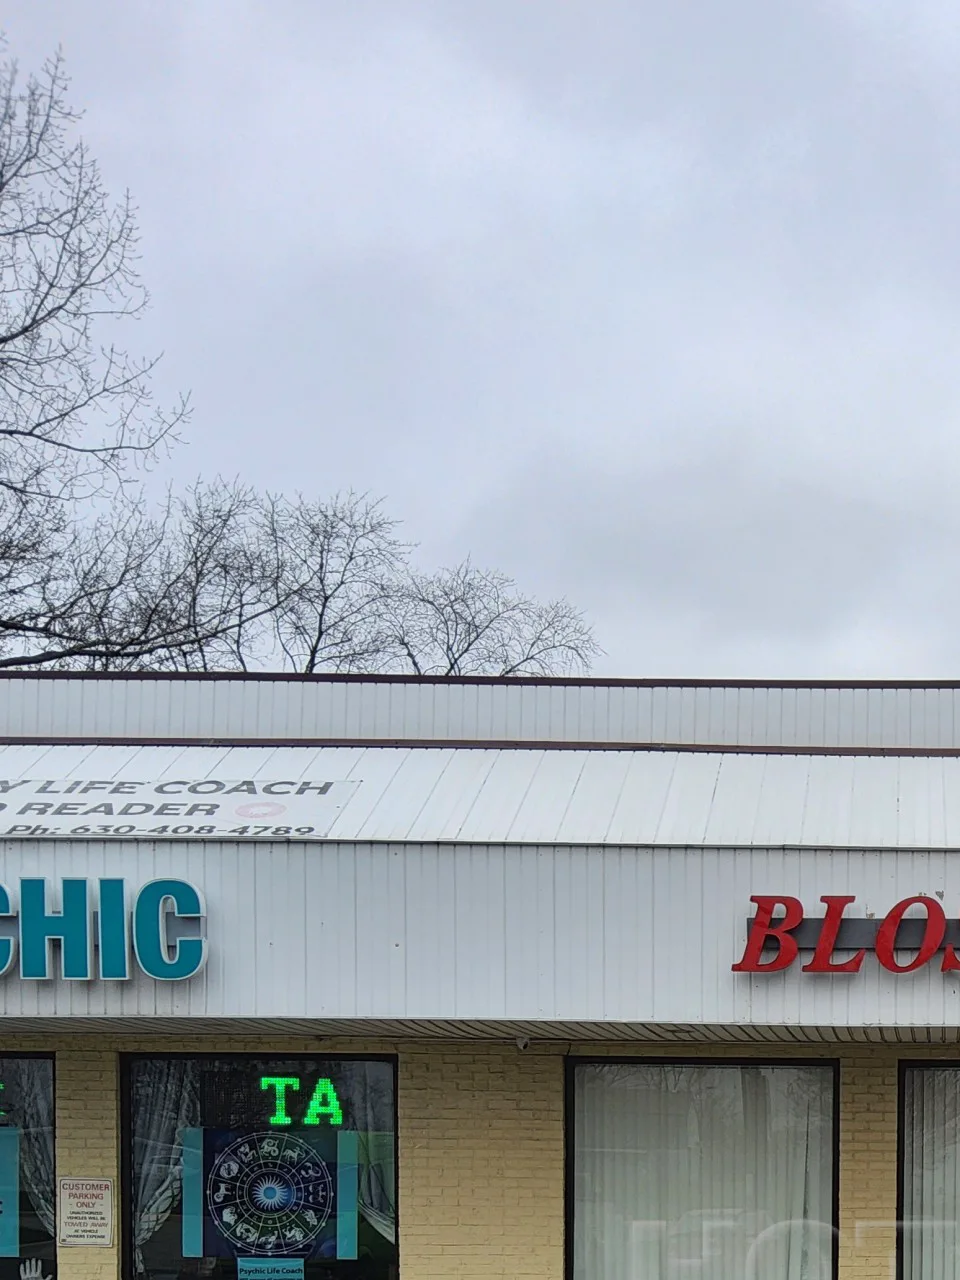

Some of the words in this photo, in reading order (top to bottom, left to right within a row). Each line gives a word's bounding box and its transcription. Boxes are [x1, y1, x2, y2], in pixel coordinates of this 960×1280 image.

[35, 780, 145, 794] LIFE
[154, 780, 334, 795] COACH
[16, 803, 220, 816] READER
[6, 825, 61, 836] Ph:
[70, 825, 315, 836] 630-408-4789
[0, 877, 208, 981] HIC
[62, 1183, 109, 1191] CUSTOMER
[68, 1192, 104, 1200] PARKING
[240, 1268, 265, 1276] Psychic
